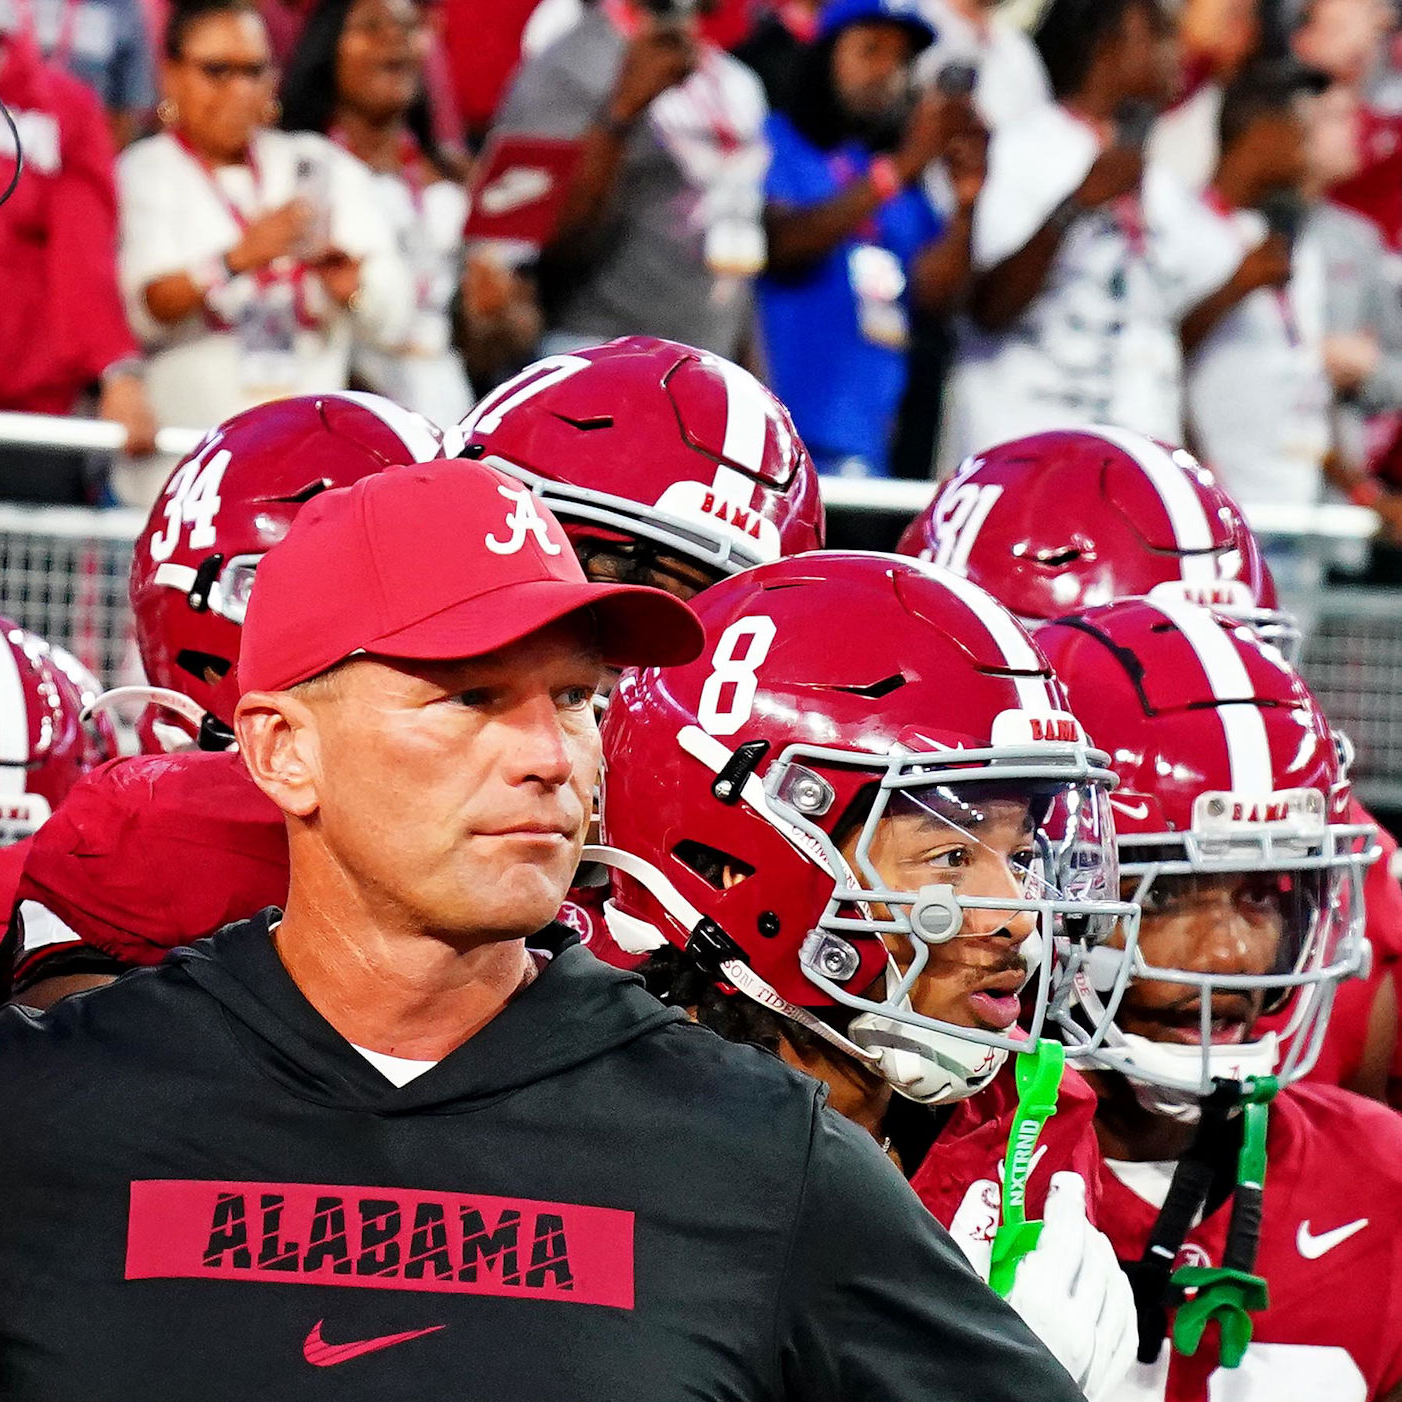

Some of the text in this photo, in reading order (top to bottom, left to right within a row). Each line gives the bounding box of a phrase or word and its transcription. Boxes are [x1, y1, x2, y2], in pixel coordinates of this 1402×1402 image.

[149, 448, 233, 563] 34
[485, 483, 562, 556] A
[700, 490, 762, 541] BAMA
[698, 614, 777, 736] 8
[1028, 717, 1081, 743] BAMA
[1231, 800, 1291, 823] BAMA
[1009, 1118, 1041, 1207] NXTRND
[201, 1191, 575, 1293] ALABAMA
